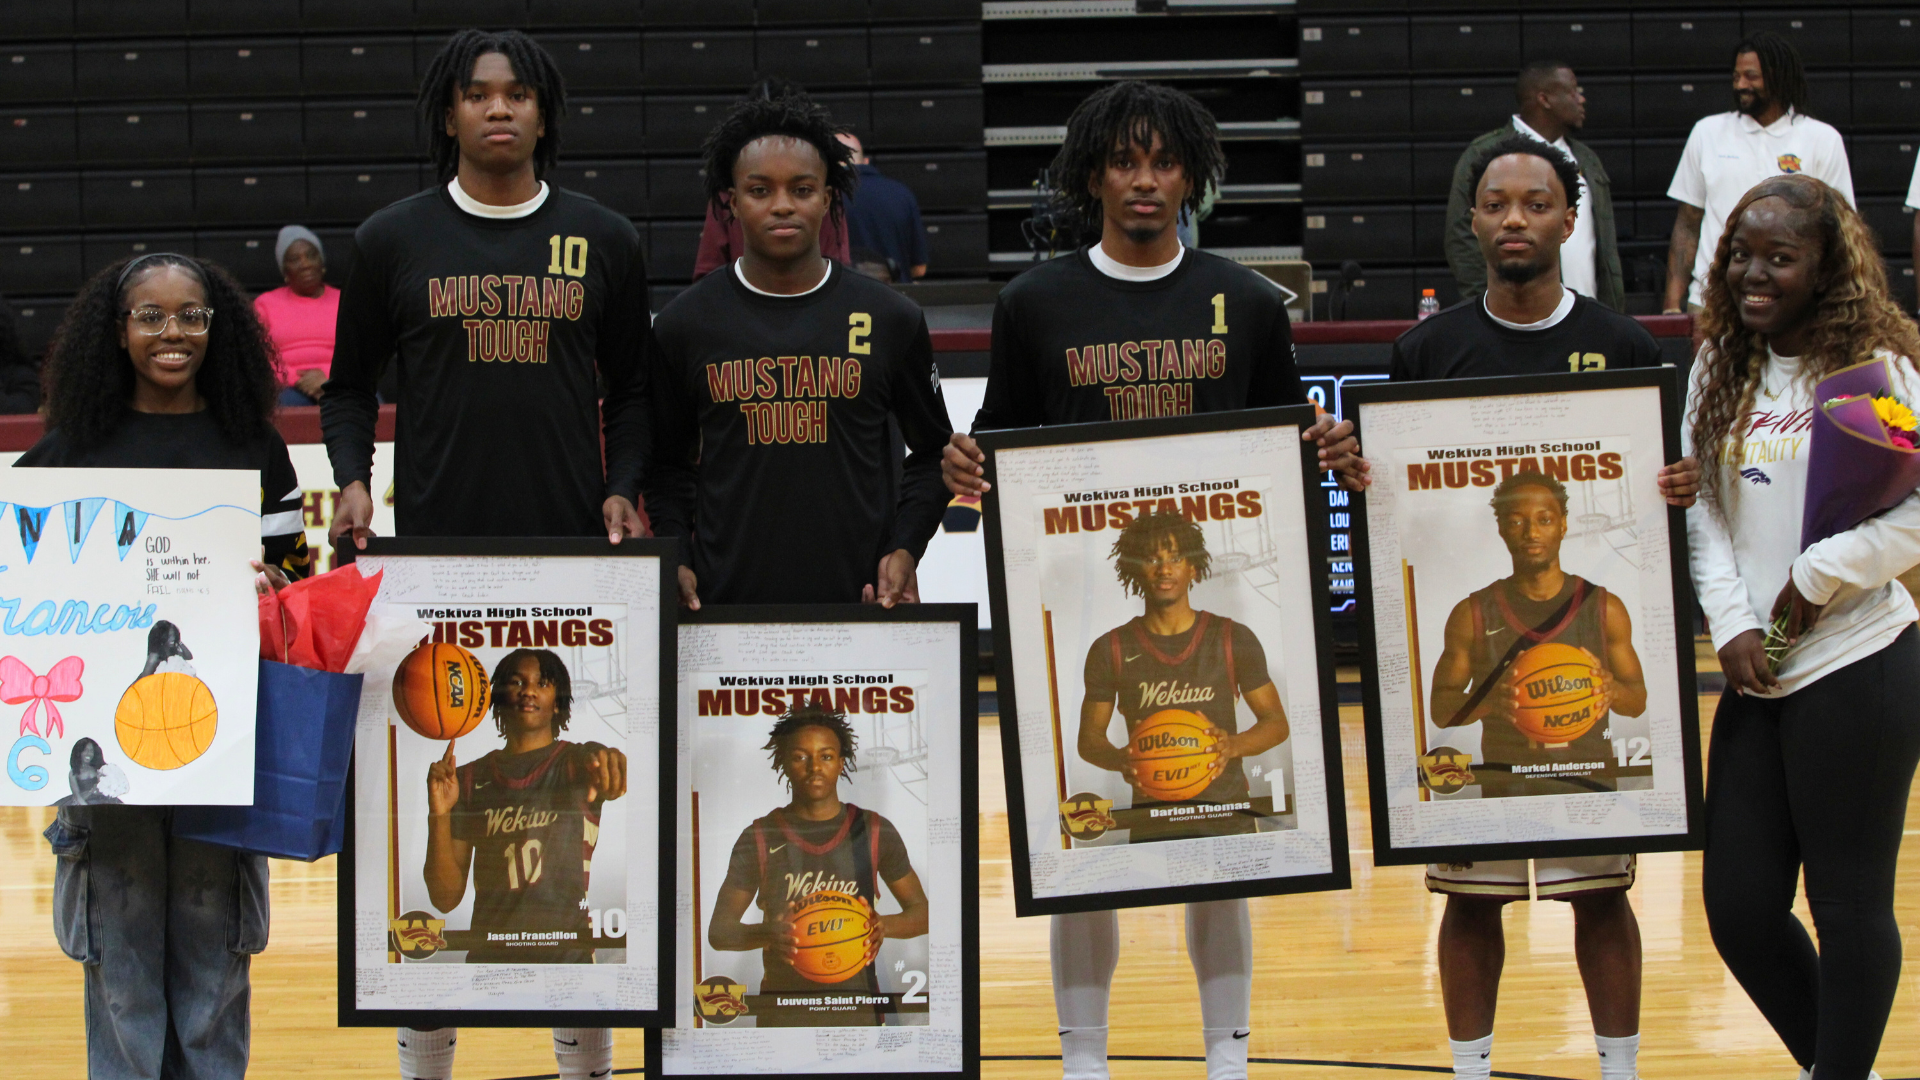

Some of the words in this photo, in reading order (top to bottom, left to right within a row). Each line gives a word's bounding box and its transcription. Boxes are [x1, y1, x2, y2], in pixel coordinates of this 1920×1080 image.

[548, 234, 588, 278] 10
[428, 274, 585, 321] MUSTANG
[1211, 293, 1228, 334] 1
[463, 319, 550, 364] TOUGH
[848, 312, 872, 355] 2
[1065, 338, 1226, 387] MUSTANG
[706, 355, 862, 403] MUSTANG
[1103, 382, 1193, 421] TOUGH
[740, 400, 827, 445] TOUGH
[1427, 447, 1492, 460] Wekiva
[1496, 444, 1536, 456] High
[1540, 440, 1601, 453] School
[1406, 452, 1624, 491] MUSTANGS
[1063, 490, 1129, 503] Wekiva
[1133, 486, 1174, 498] High
[1178, 479, 1240, 493] School
[1043, 490, 1263, 535] MUSTANGS
[145, 536, 171, 553] GOD
[146, 557, 154, 566] is
[161, 555, 189, 566] within
[146, 567, 160, 581] SHE
[163, 570, 181, 581] will
[187, 569, 201, 581] not
[416, 608, 483, 619] Wekiva
[486, 607, 527, 618] High
[531, 606, 593, 617] School
[412, 618, 614, 649] USTANGS
[446, 660, 464, 708] NCAA
[718, 676, 785, 687] Wekiva
[788, 674, 828, 686] High
[832, 673, 894, 685] School
[1138, 679, 1215, 710] Wekiva
[1525, 674, 1594, 700] Wilson
[697, 685, 915, 717] MUSTANGS
[1543, 706, 1591, 728] NCAA
[1137, 731, 1200, 753] Wilson
[7, 735, 52, 791] 6
[1511, 763, 1550, 774] Markel
[1551, 761, 1605, 771] Anderson
[484, 804, 559, 837] Wekiva
[1150, 805, 1195, 818] Darion
[1196, 801, 1251, 813] Thomas
[504, 839, 543, 890] 10
[784, 870, 859, 901] Wekiva
[487, 932, 520, 941] Jasen
[521, 931, 578, 941] Francillon
[776, 997, 823, 1006] Louvens
[824, 996, 854, 1005] Saint
[855, 996, 889, 1005] Pierre
